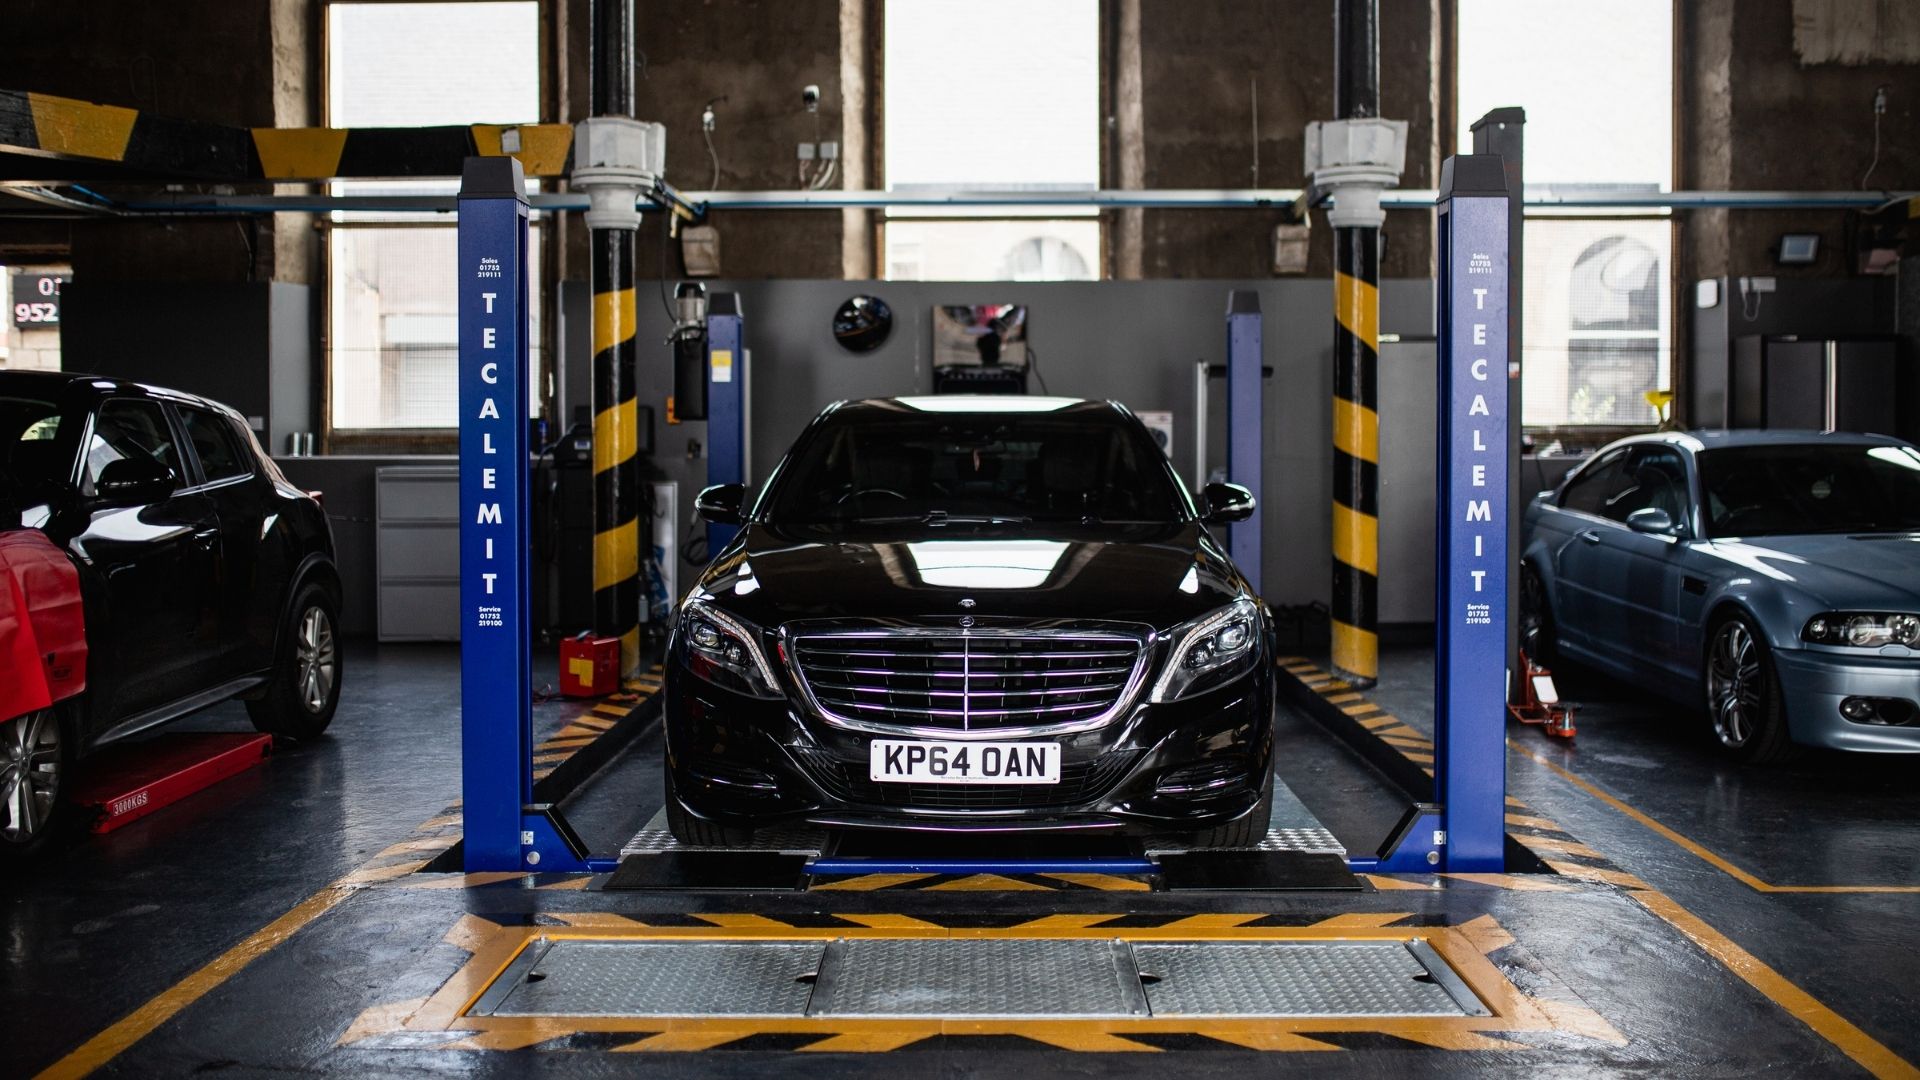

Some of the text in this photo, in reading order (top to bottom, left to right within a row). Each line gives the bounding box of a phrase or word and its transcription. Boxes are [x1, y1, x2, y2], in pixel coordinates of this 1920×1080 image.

[477, 292, 502, 594] TECALEMIT
[1466, 288, 1491, 592] TECALEMIT
[114, 793, 147, 815] 3000KGS
[884, 744, 1046, 777] KP64 OAN
